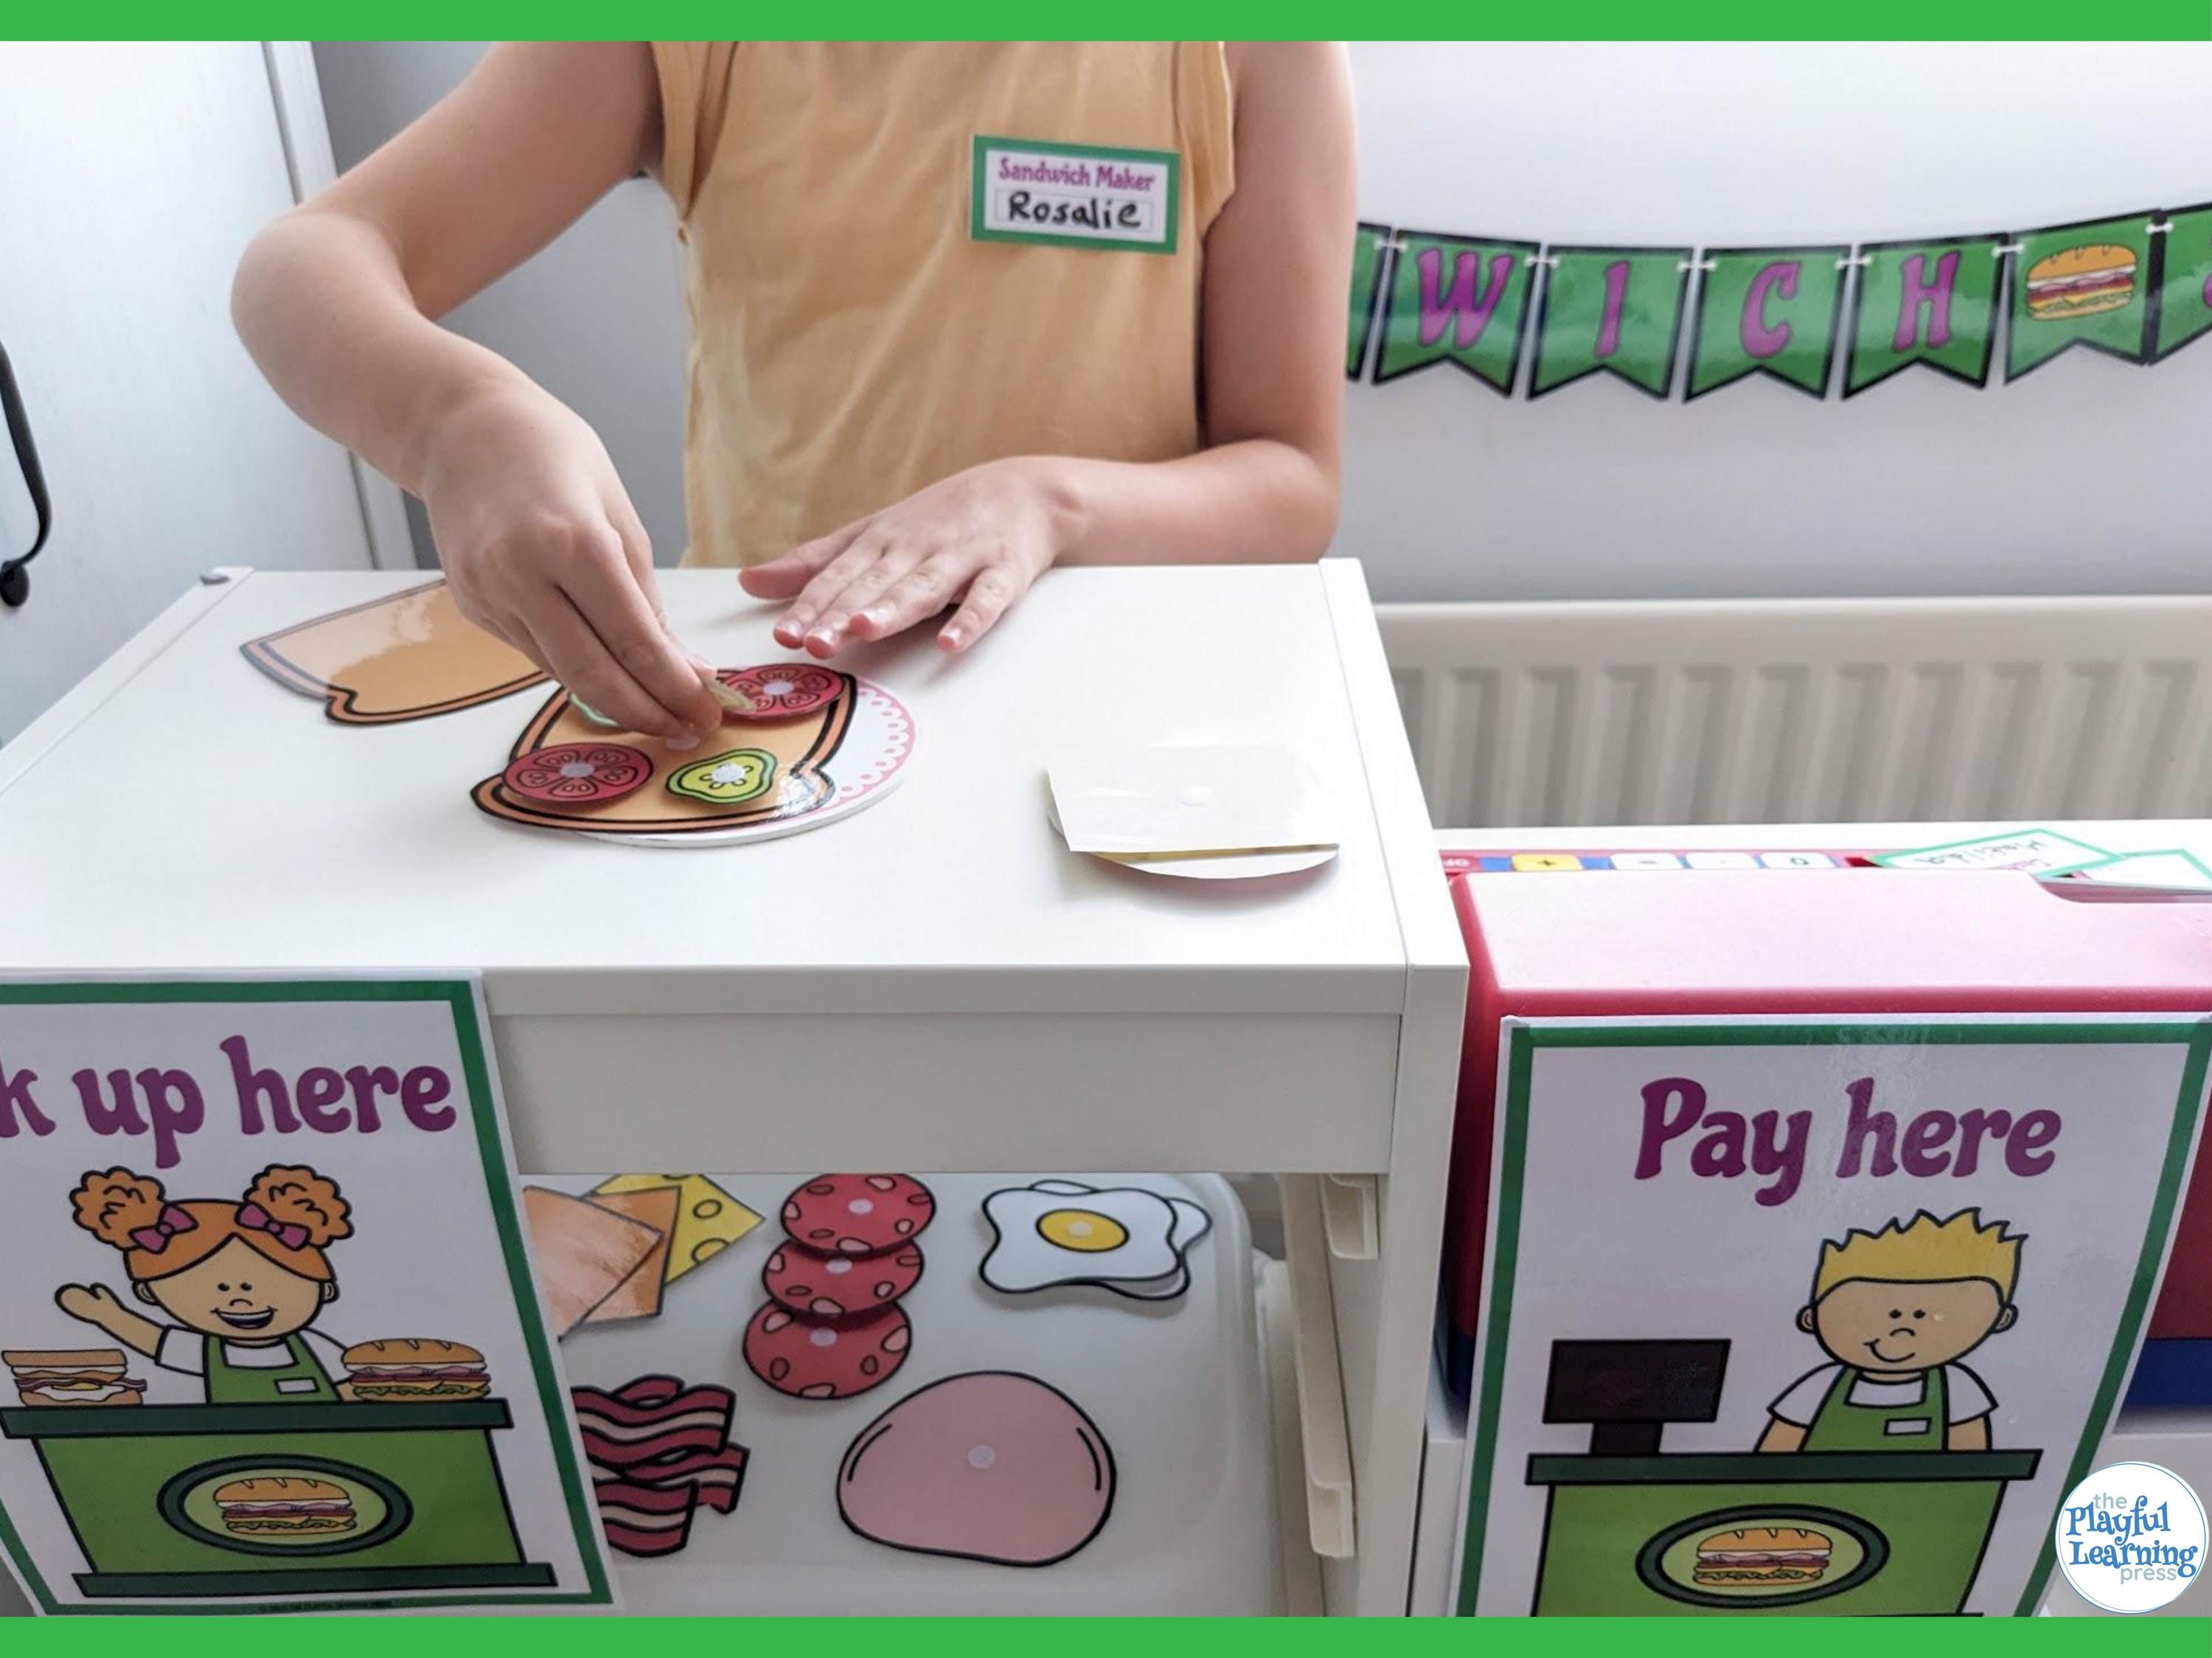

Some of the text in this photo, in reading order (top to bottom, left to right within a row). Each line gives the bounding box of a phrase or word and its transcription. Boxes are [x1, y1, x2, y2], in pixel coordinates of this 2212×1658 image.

[998, 156, 1155, 192] Sandwich Maker
[1008, 189, 1141, 230] Rosalie
[72, 1067, 205, 1169] up
[220, 1034, 457, 1135] here
[1634, 1077, 2062, 1207] Pay here
